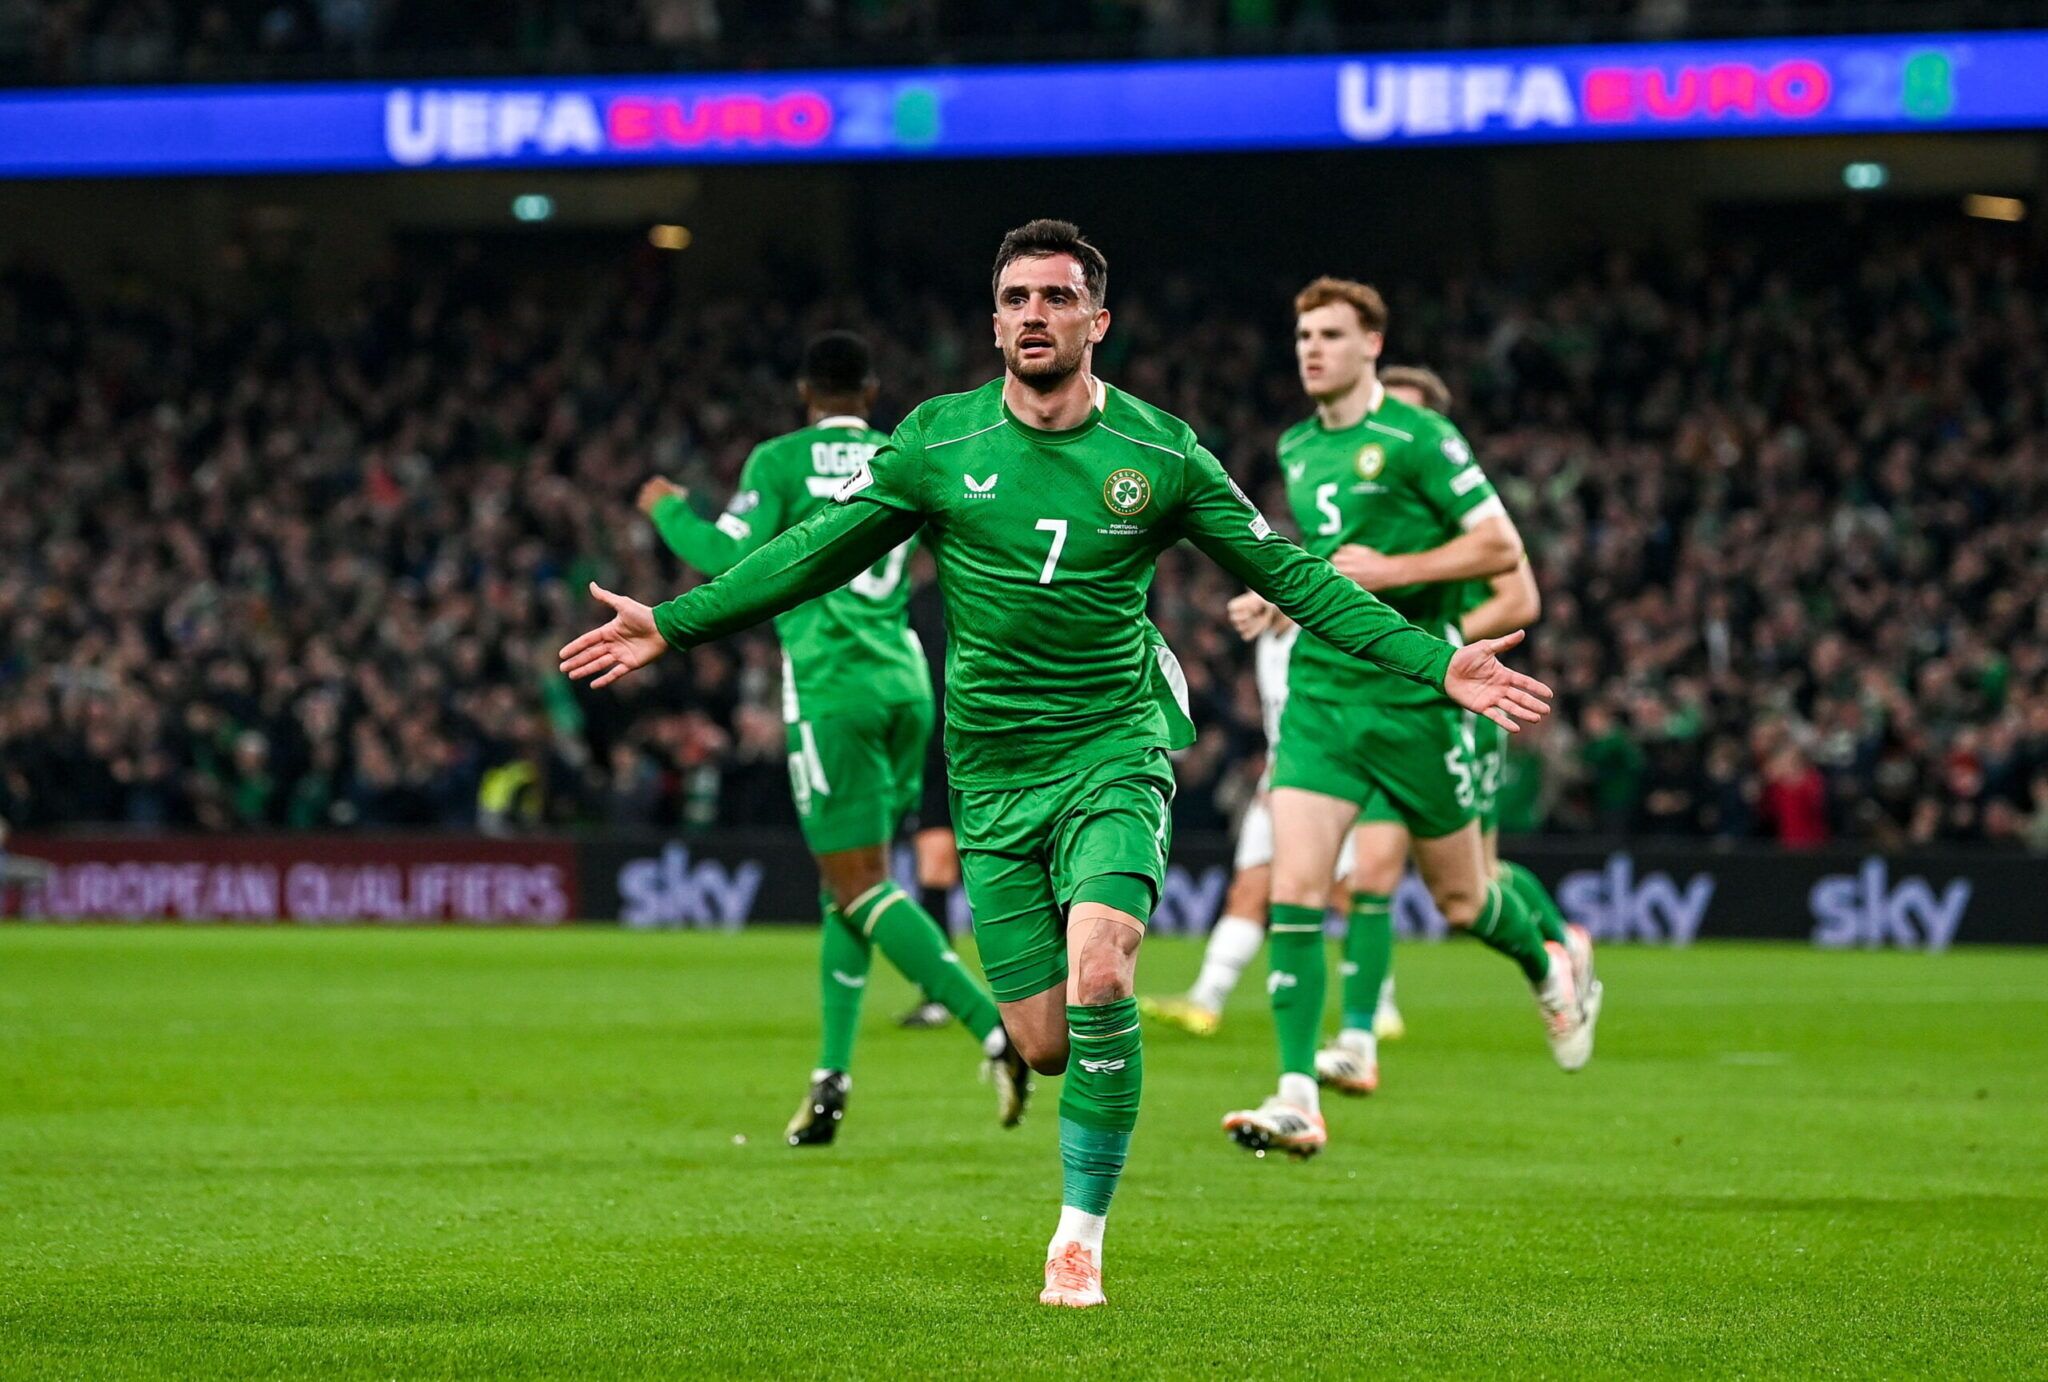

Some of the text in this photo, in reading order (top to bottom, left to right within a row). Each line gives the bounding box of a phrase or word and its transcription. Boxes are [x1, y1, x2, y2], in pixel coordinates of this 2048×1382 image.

[384, 90, 600, 166] UEFA
[607, 92, 832, 149] EURO
[1339, 60, 1575, 142] UEFA
[1582, 58, 1830, 123] EURO
[1109, 472, 1147, 488] IRELAND
[1315, 482, 1342, 536] 5
[1034, 518, 1068, 584] 7
[285, 861, 568, 923] QUALIFIERS
[617, 840, 762, 934] sky
[1558, 853, 1714, 948] sky
[1810, 857, 1972, 952] sky
